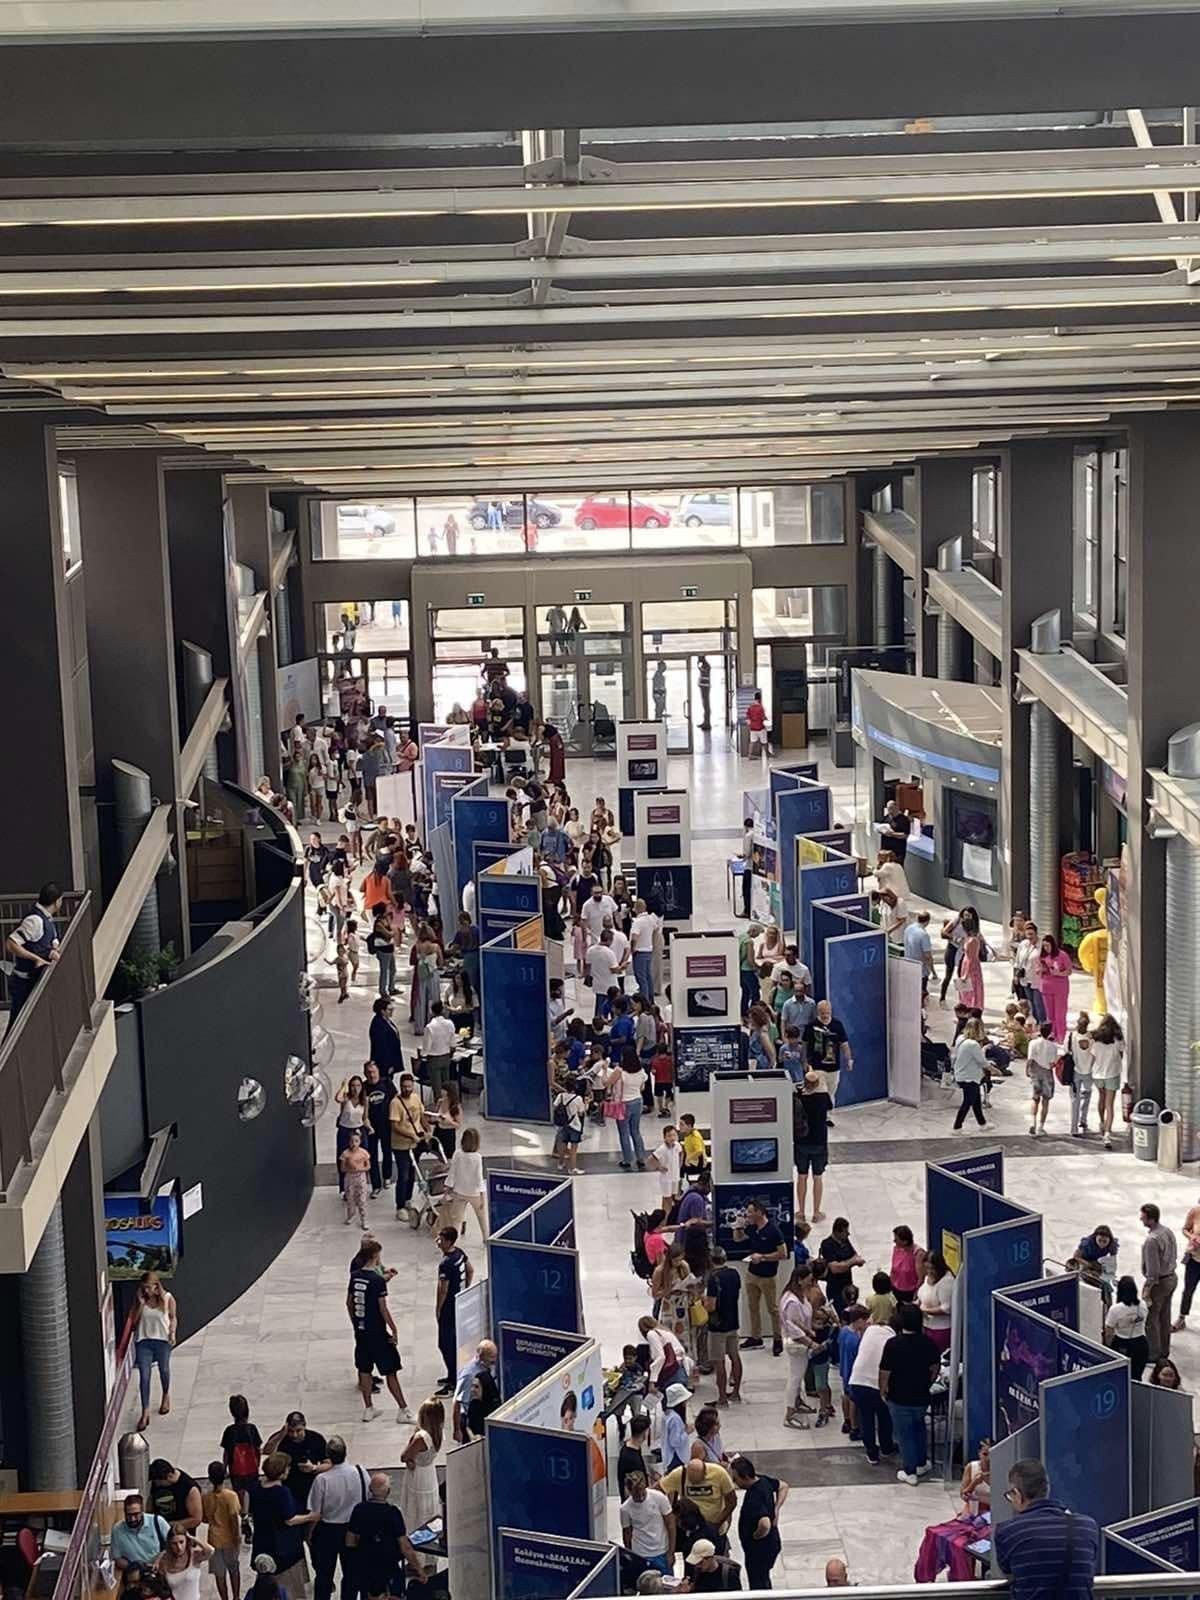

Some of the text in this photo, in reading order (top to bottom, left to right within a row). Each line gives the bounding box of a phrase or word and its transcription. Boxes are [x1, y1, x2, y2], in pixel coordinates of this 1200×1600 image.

[809, 801, 822, 816] 15
[489, 811, 497, 824] 9
[835, 874, 849, 889] 16
[863, 946, 877, 962] 17
[521, 966, 534, 981] 11
[1013, 1240, 1030, 1262] 18
[541, 1269, 561, 1290] 12
[1095, 1389, 1116, 1414] 19
[549, 1455, 569, 1480] 13
